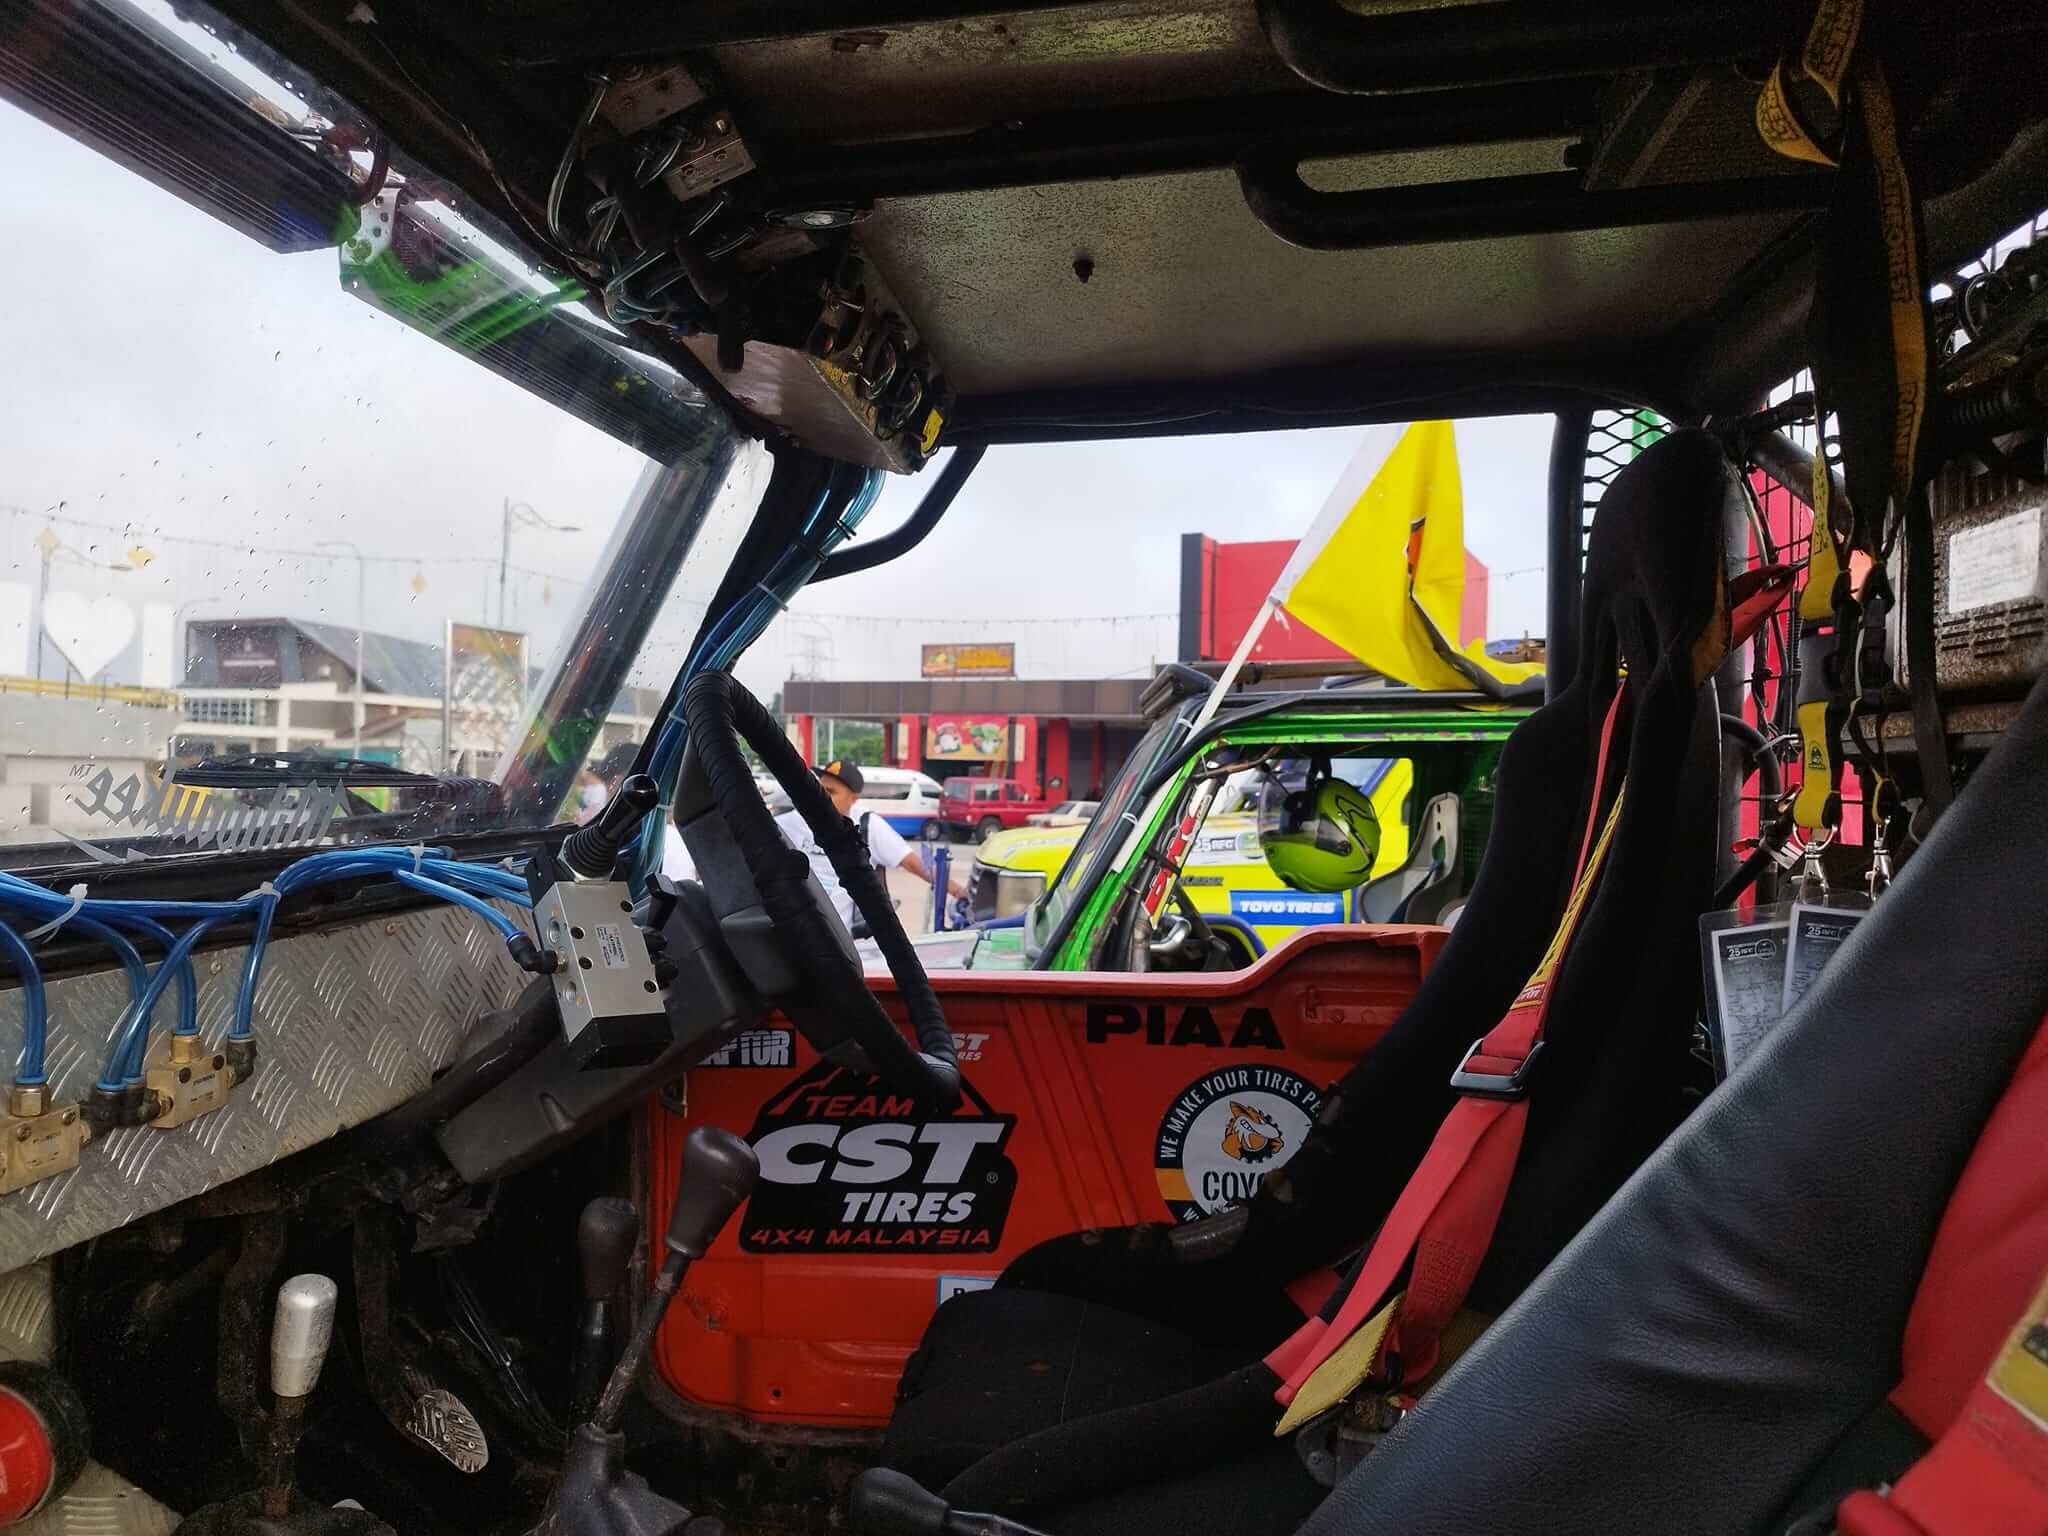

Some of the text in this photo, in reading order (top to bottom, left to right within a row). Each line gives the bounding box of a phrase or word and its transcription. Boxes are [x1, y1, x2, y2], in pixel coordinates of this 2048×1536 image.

[1239, 900, 1336, 914] TOYO TIRES
[1085, 1003, 1286, 1050] PIAA
[697, 1029, 791, 1066] PTOR
[952, 1033, 992, 1050] ST
[1201, 1069, 1249, 1097] YOUR
[1255, 1069, 1304, 1099] TIRES
[804, 1094, 913, 1118] TEAM
[1166, 1087, 1206, 1134] MAKE
[754, 1121, 1005, 1185] CST
[1159, 1136, 1179, 1159] WE
[842, 1191, 977, 1224] TIRES
[826, 1227, 992, 1246] MALAYSIA
